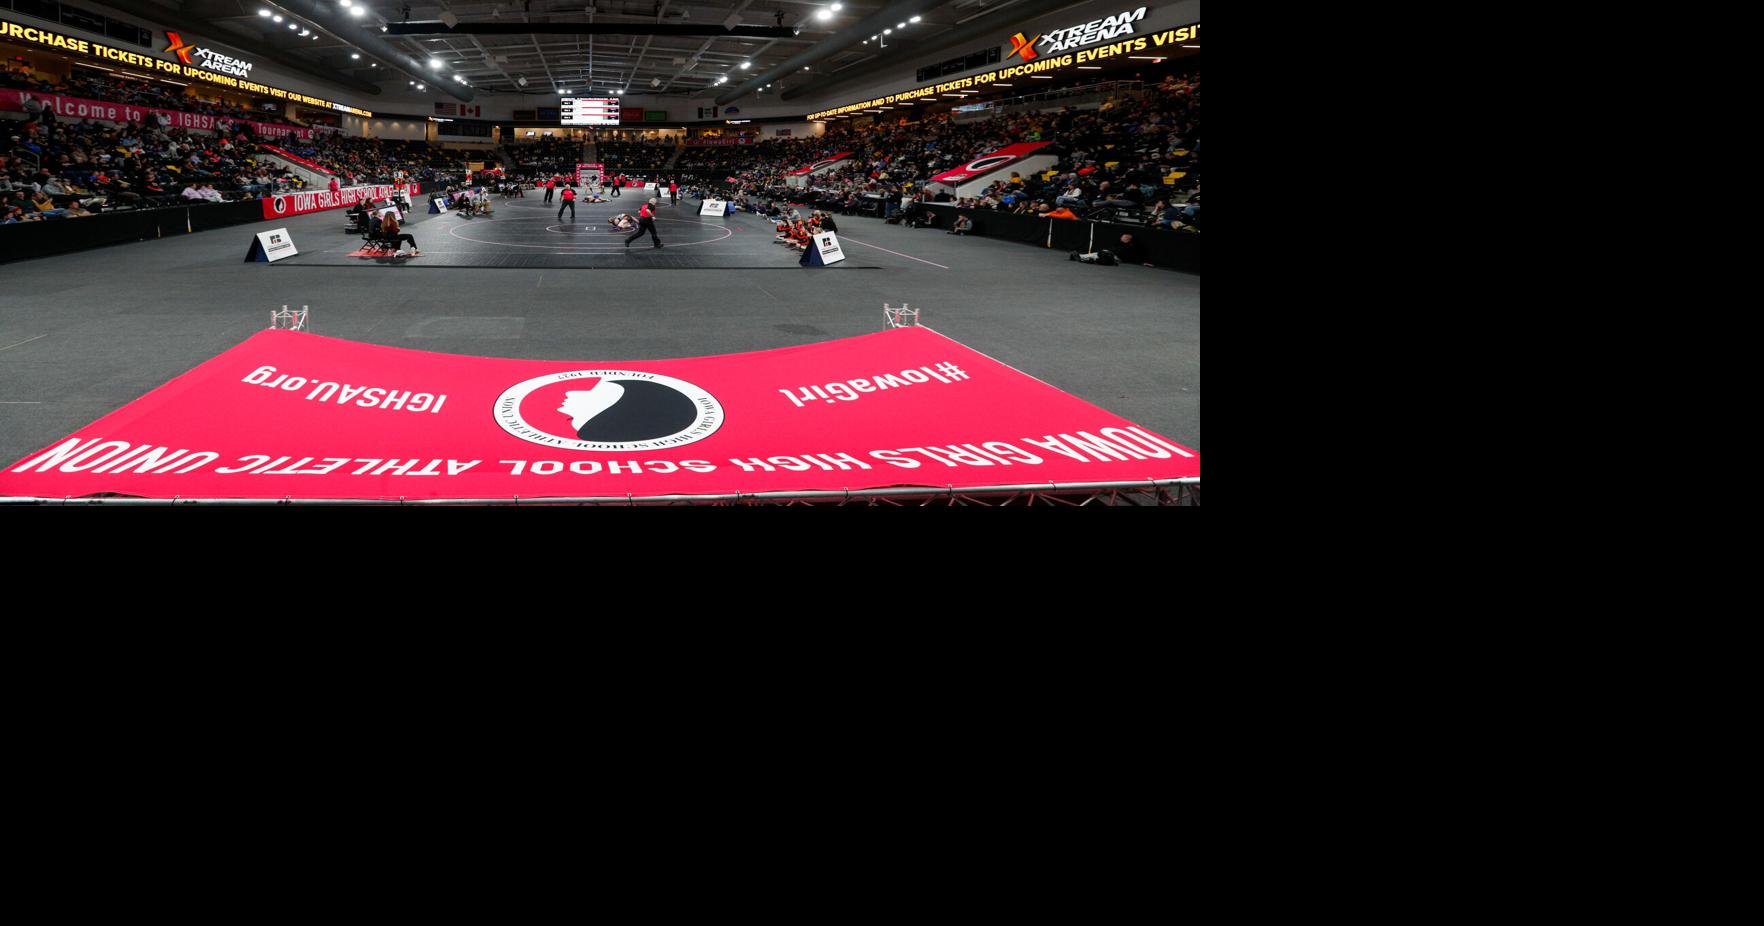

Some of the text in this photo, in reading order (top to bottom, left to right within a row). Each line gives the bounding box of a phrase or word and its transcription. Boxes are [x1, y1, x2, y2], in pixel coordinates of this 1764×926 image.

[1038, 6, 1147, 47] XTREAM
[1047, 22, 1134, 54] ARENA
[193, 47, 252, 71] XTREAM
[200, 59, 248, 78] ARENA
[838, 101, 872, 114] INFORMATION
[872, 98, 885, 107] AND
[886, 95, 894, 103] TO
[895, 85, 934, 102] PURCHASE
[936, 77, 973, 93] TICKETS
[974, 71, 996, 86] FOR
[999, 54, 1073, 79] UPCOMING
[1076, 37, 1147, 64] EVENTS
[1152, 24, 1200, 46] VISI
[93, 43, 153, 68] TICKETS
[156, 59, 181, 75] FOR
[183, 67, 237, 87] UPCOMING
[239, 81, 269, 95] EVENTS
[270, 87, 287, 99] VISIT
[288, 92, 302, 102] OUR
[302, 95, 326, 107] WEBSITE
[125, 106, 141, 122] to
[294, 194, 317, 212] IOWA
[318, 190, 340, 208] GIRLS
[341, 187, 357, 205] HIGH
[357, 185, 379, 201] SCHOOL
[241, 365, 447, 414] IGHSAU.org
[779, 361, 972, 408] #IowaGirl
[697, 398, 715, 415] IOWA
[690, 416, 715, 436] GIRLS
[11, 426, 1195, 476] IOWA GIRLS HIGH SCHOOL ATHLETIC UNION
[577, 442, 649, 450] SCHOOL
